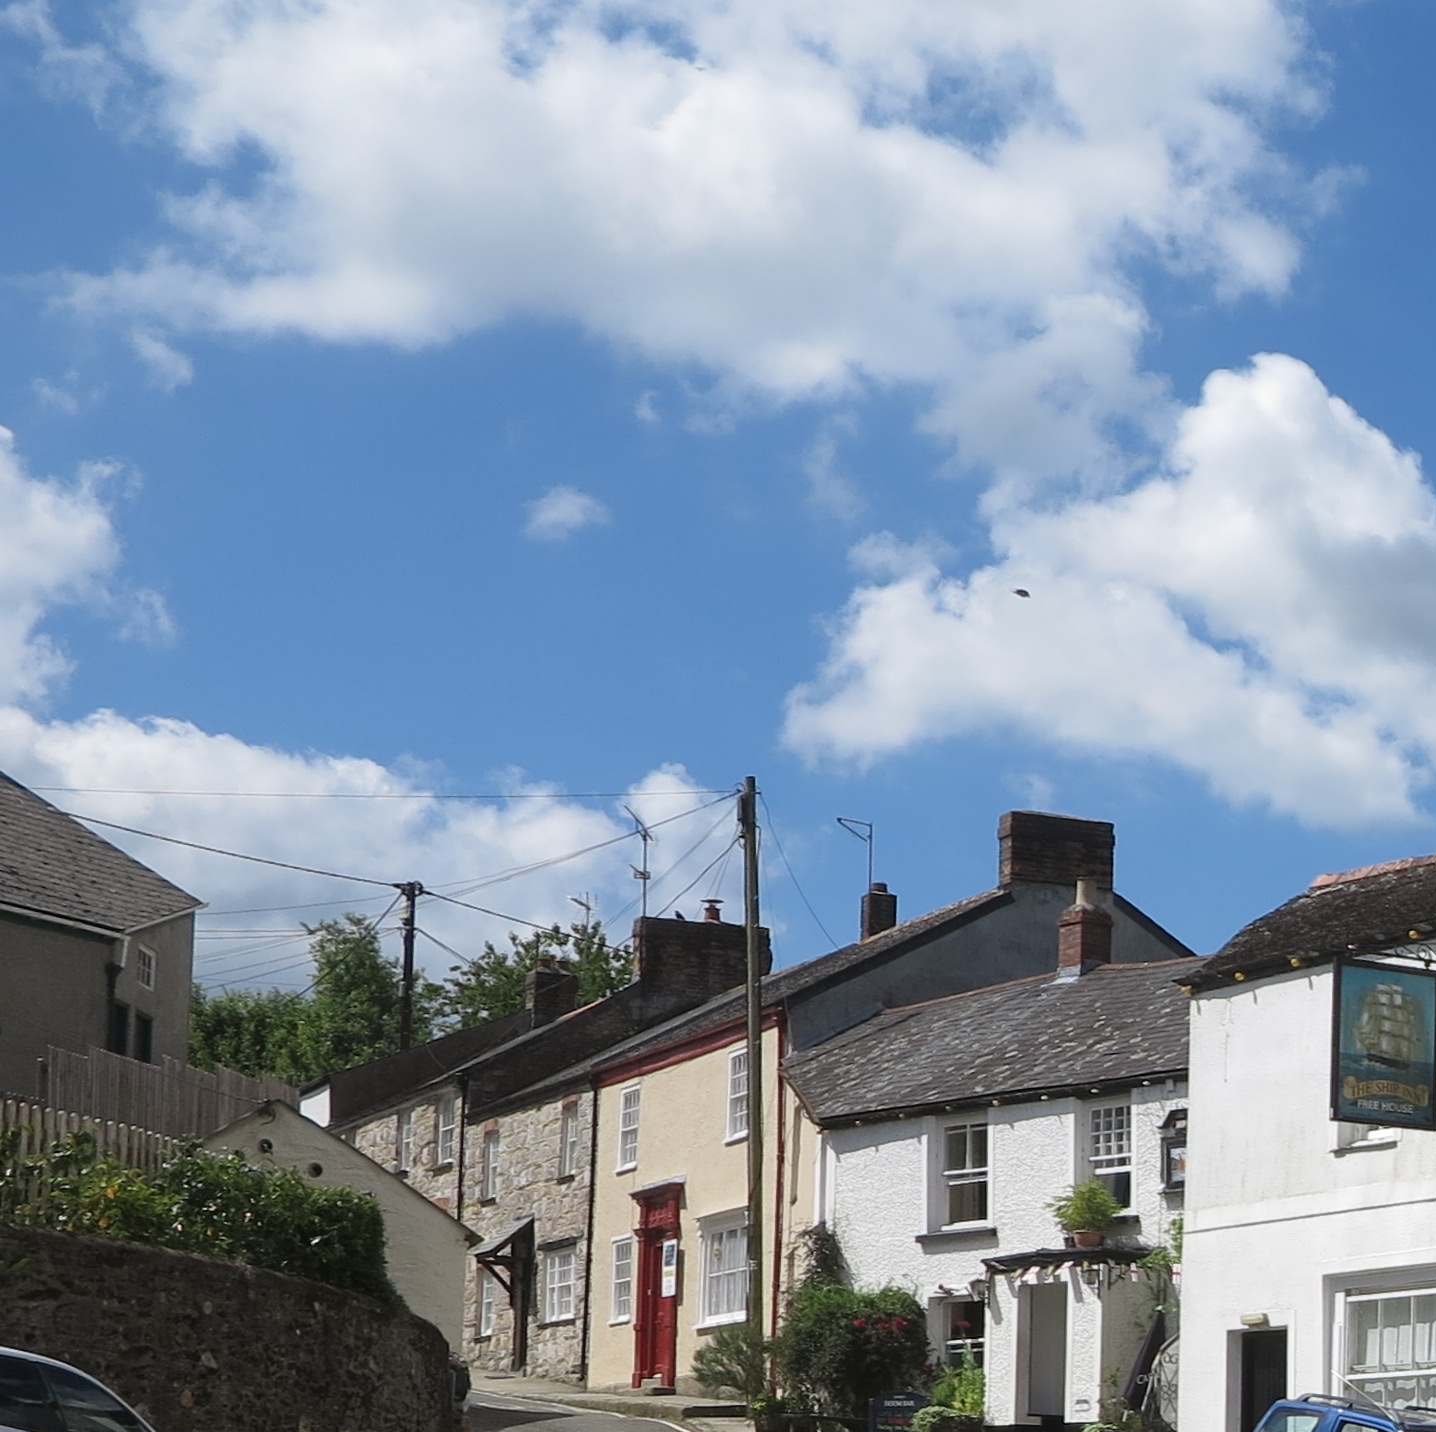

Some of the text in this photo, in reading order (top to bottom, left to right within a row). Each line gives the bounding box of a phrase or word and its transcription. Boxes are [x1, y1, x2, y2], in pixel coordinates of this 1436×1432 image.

[1351, 1082, 1427, 1104] THE SHIP INN
[1357, 1099, 1414, 1114] FREE HOUSE
